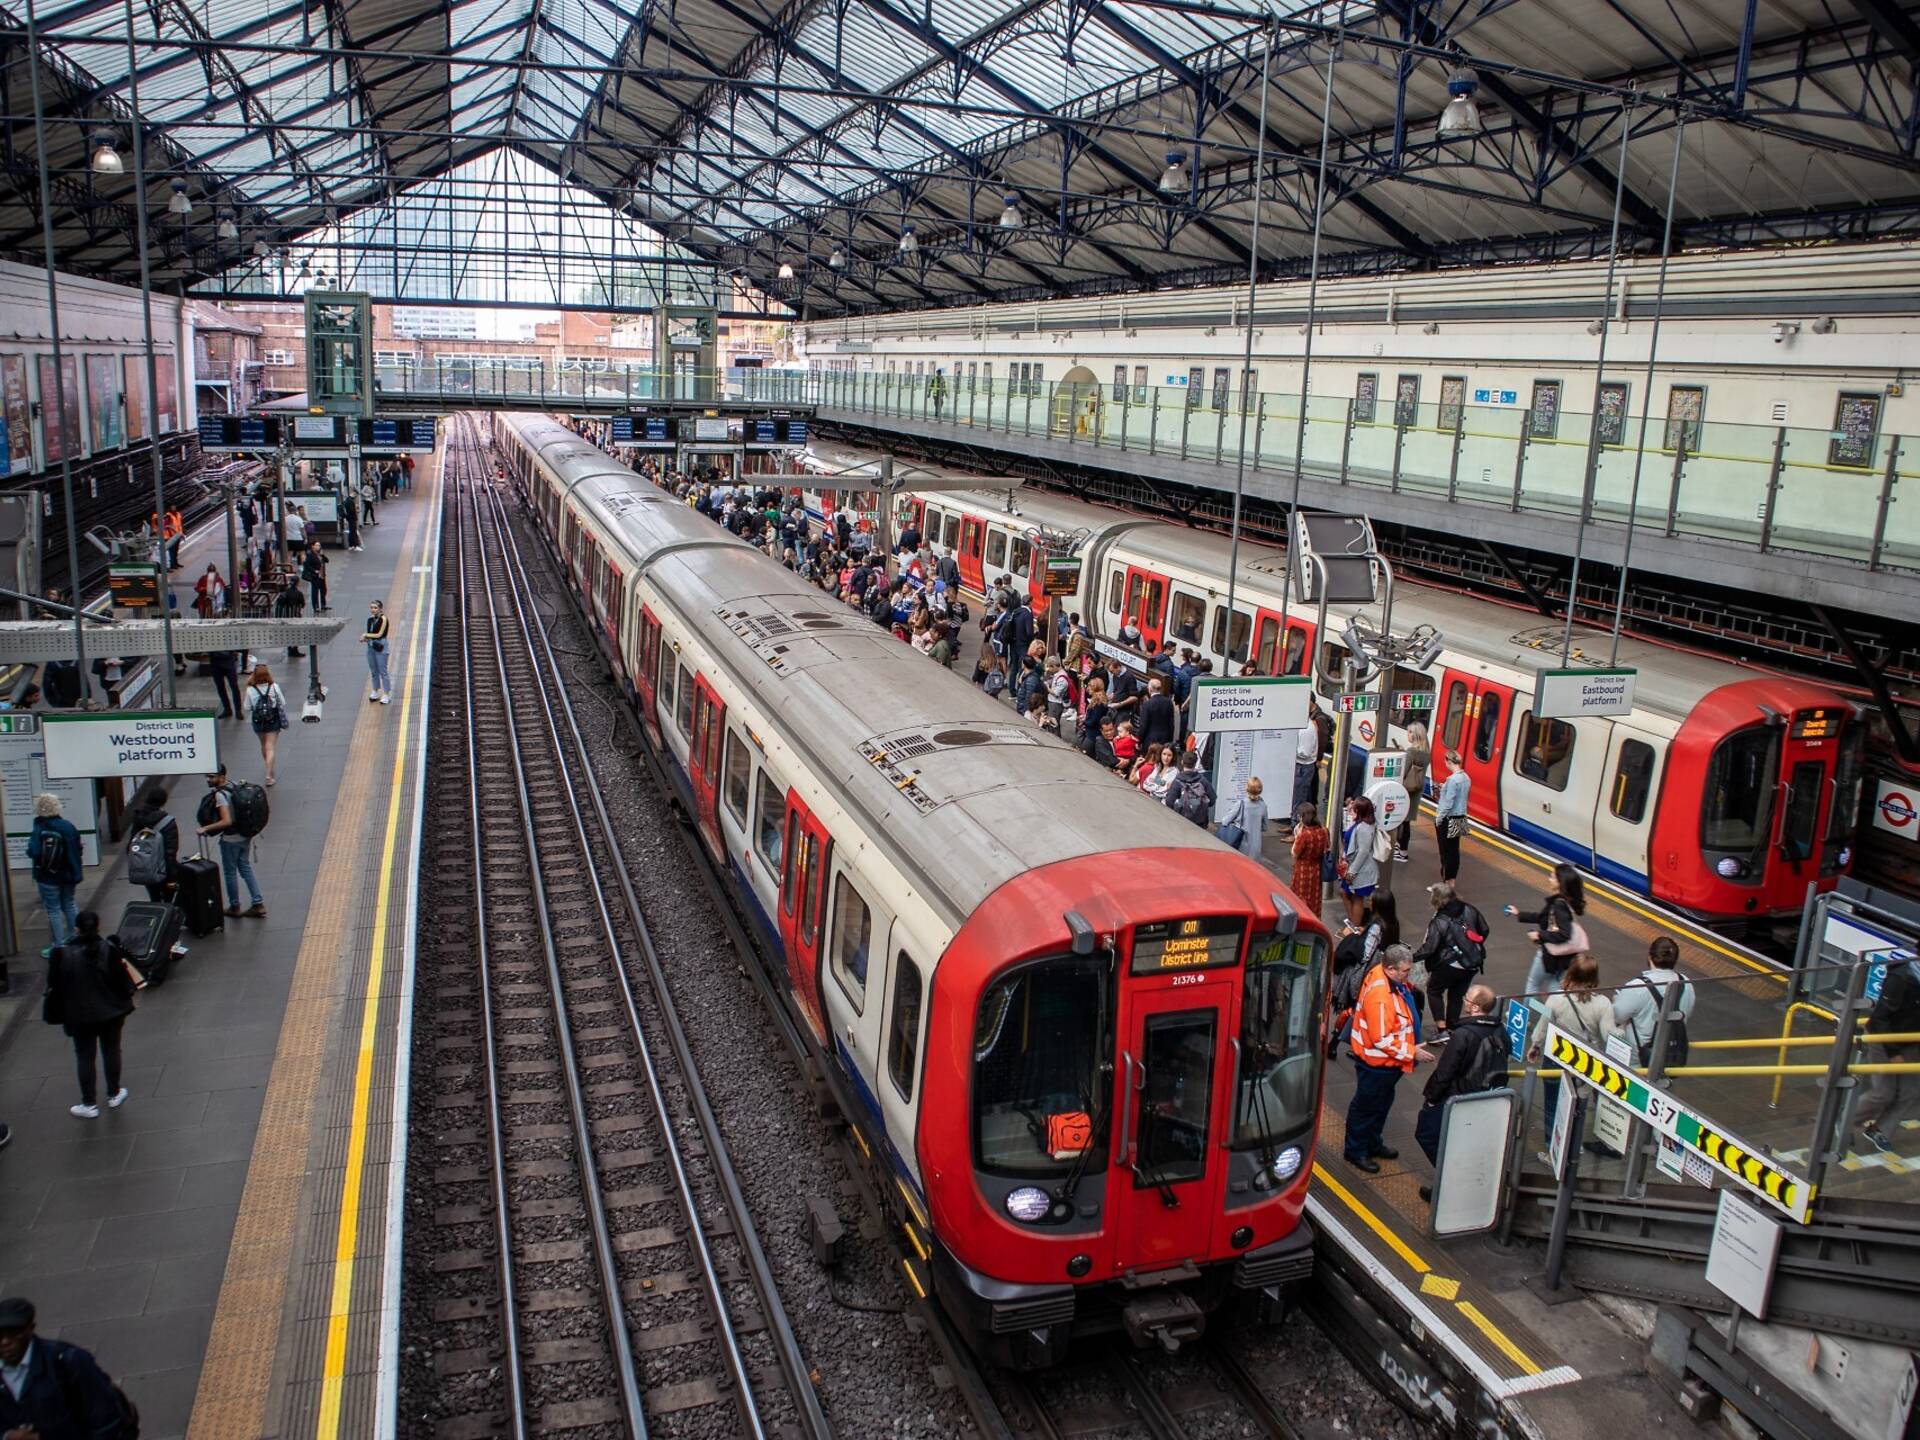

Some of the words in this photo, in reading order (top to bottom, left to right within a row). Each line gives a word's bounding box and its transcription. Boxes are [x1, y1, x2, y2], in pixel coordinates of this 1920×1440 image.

[1582, 685, 1624, 694] Eastbound
[1211, 696, 1264, 708] Eastbound
[1582, 696, 1617, 707] platform
[1210, 709, 1254, 721] platform
[1256, 708, 1262, 718] 2
[136, 722, 174, 731] District
[176, 722, 194, 730] line
[110, 732, 195, 746] Westbound
[119, 748, 182, 763] platform
[187, 748, 196, 759] 3
[1183, 920, 1197, 934] 011
[1166, 938, 1209, 952] Upminster
[1162, 953, 1191, 966] District
[1193, 952, 1208, 964] line
[1172, 975, 1196, 985] 21376
